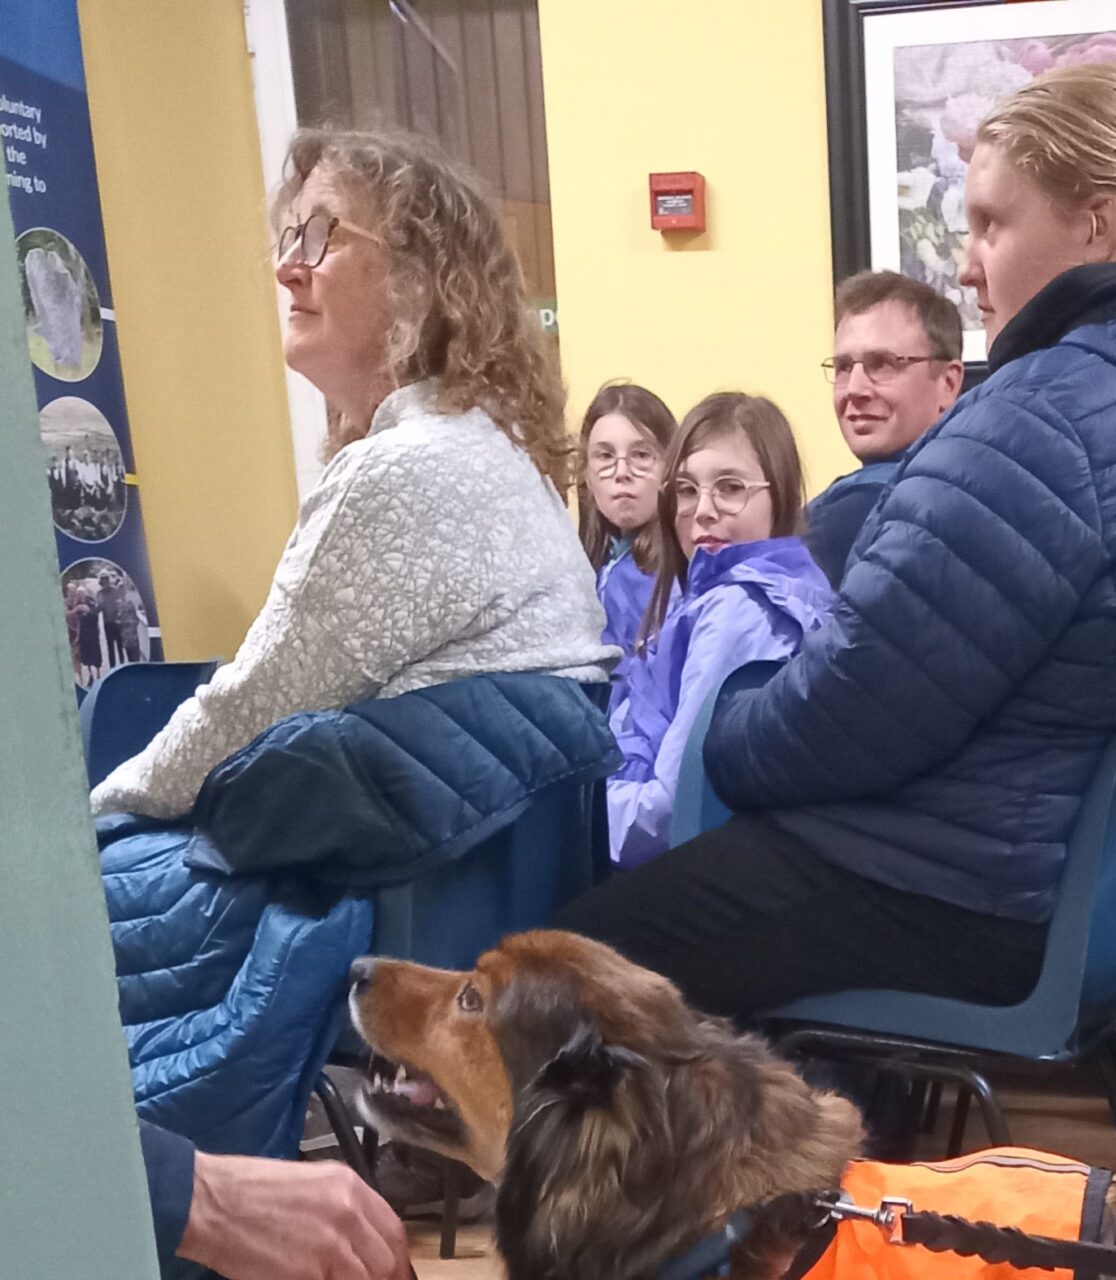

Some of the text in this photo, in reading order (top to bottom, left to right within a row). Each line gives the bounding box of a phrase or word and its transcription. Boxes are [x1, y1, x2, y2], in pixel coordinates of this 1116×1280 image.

[0, 94, 41, 123] oluntary
[0, 123, 47, 149] orted by
[6, 145, 27, 165] the
[6, 170, 47, 193] ning to
